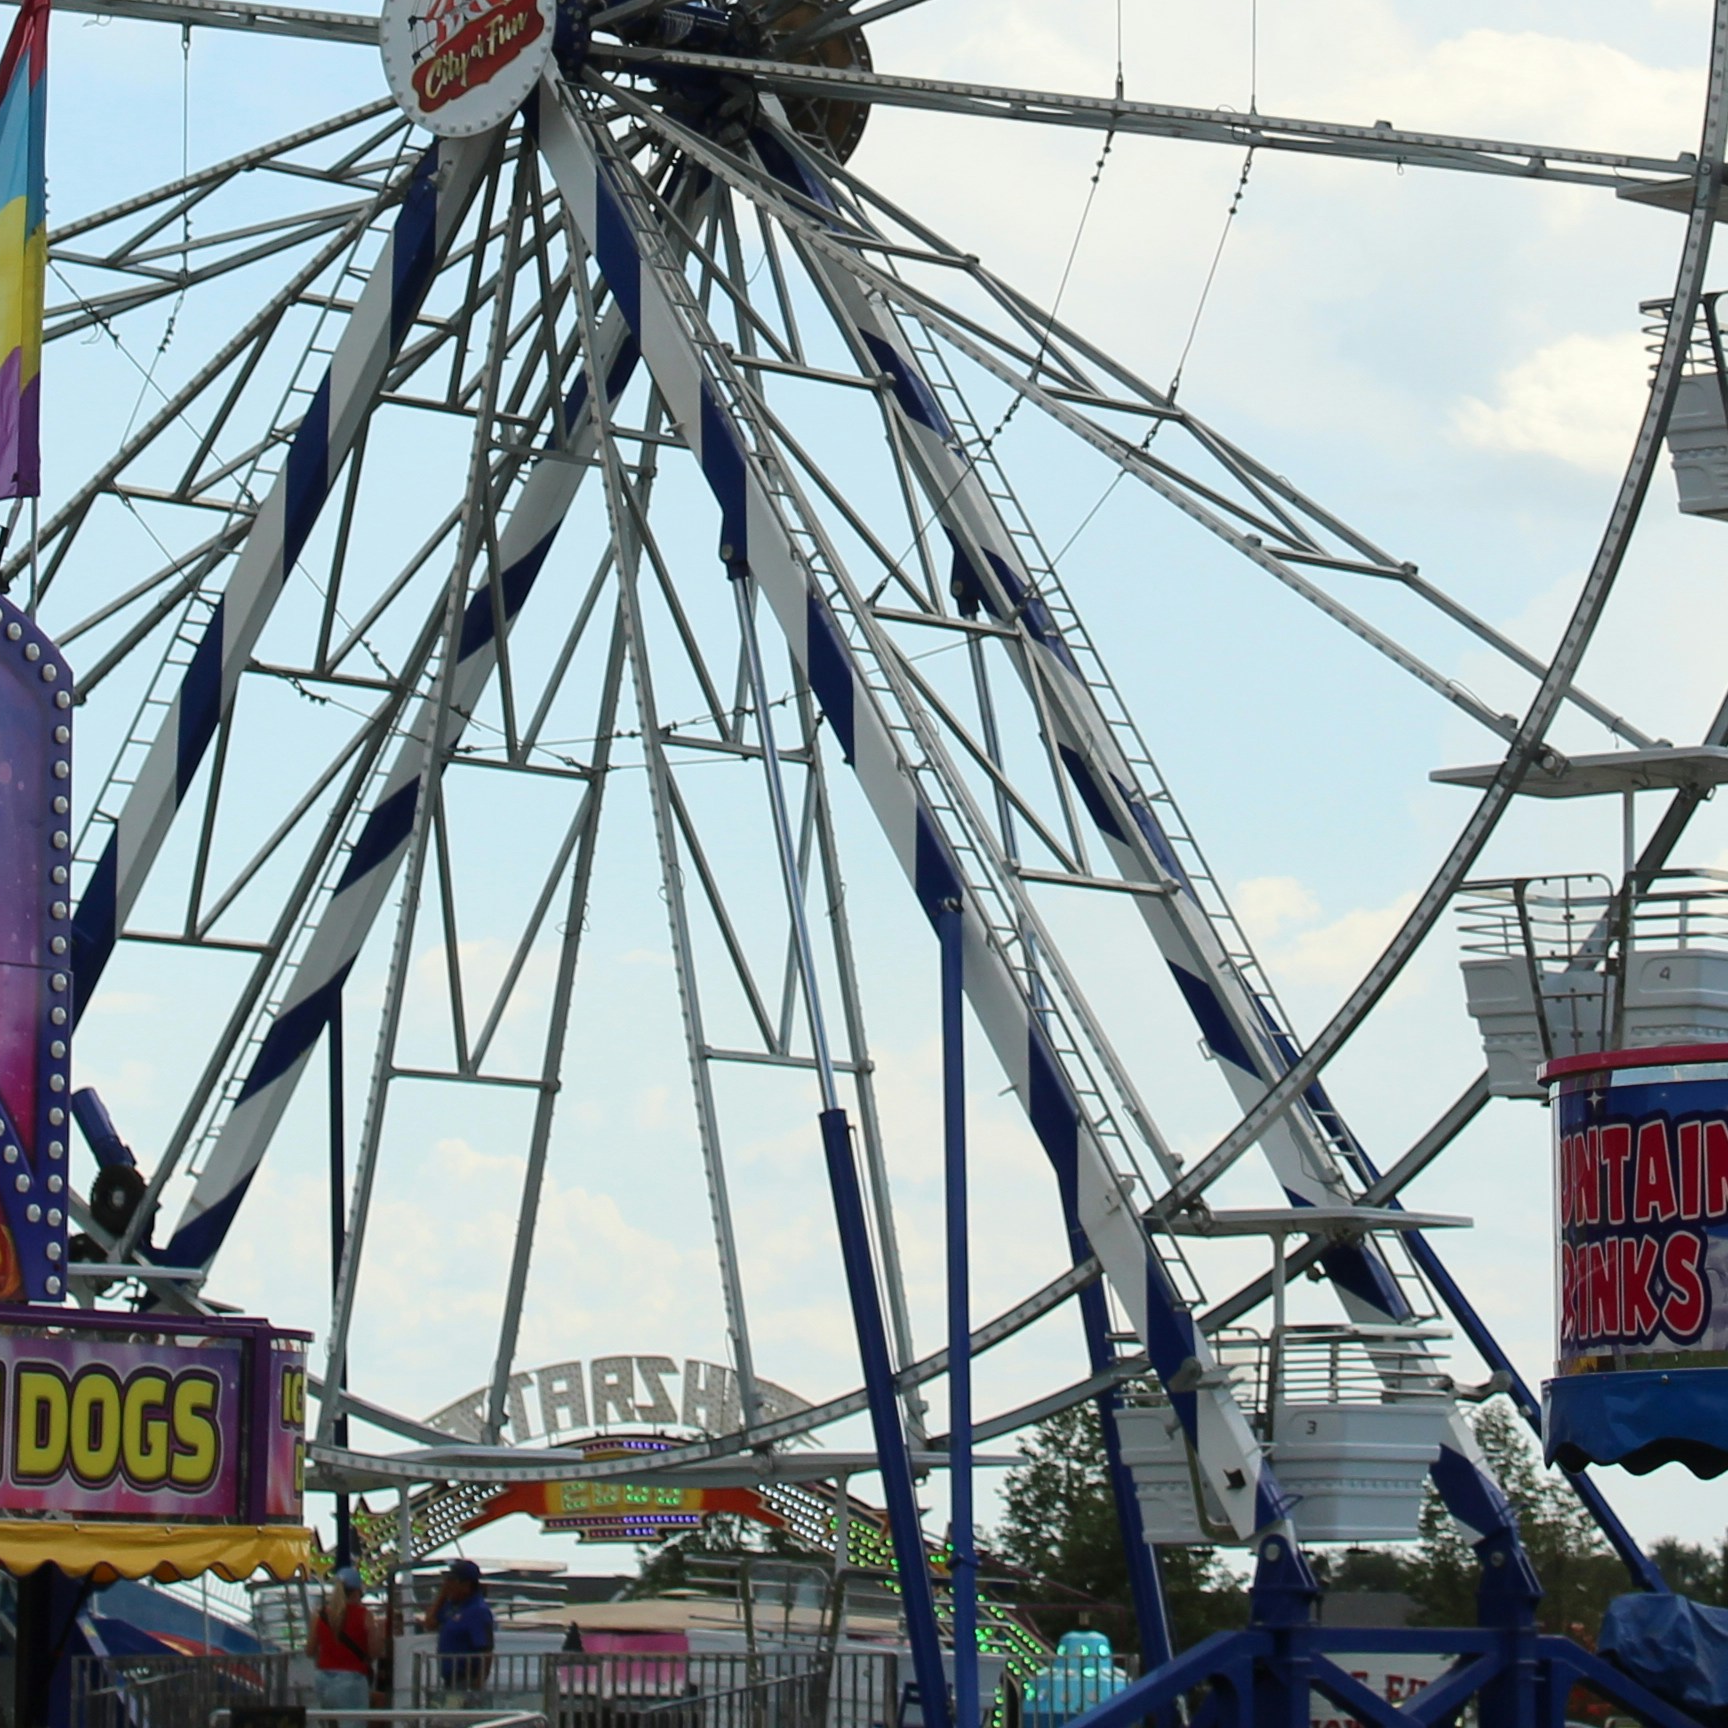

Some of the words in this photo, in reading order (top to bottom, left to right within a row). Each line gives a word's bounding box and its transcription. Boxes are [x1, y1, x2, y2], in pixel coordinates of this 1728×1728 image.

[424, 49, 471, 100] City
[470, 33, 485, 58] of
[484, 9, 529, 56] Fun
[1658, 966, 1671, 982] 4
[16, 1370, 219, 1487] DOGS
[1305, 1420, 1317, 1435] 3
